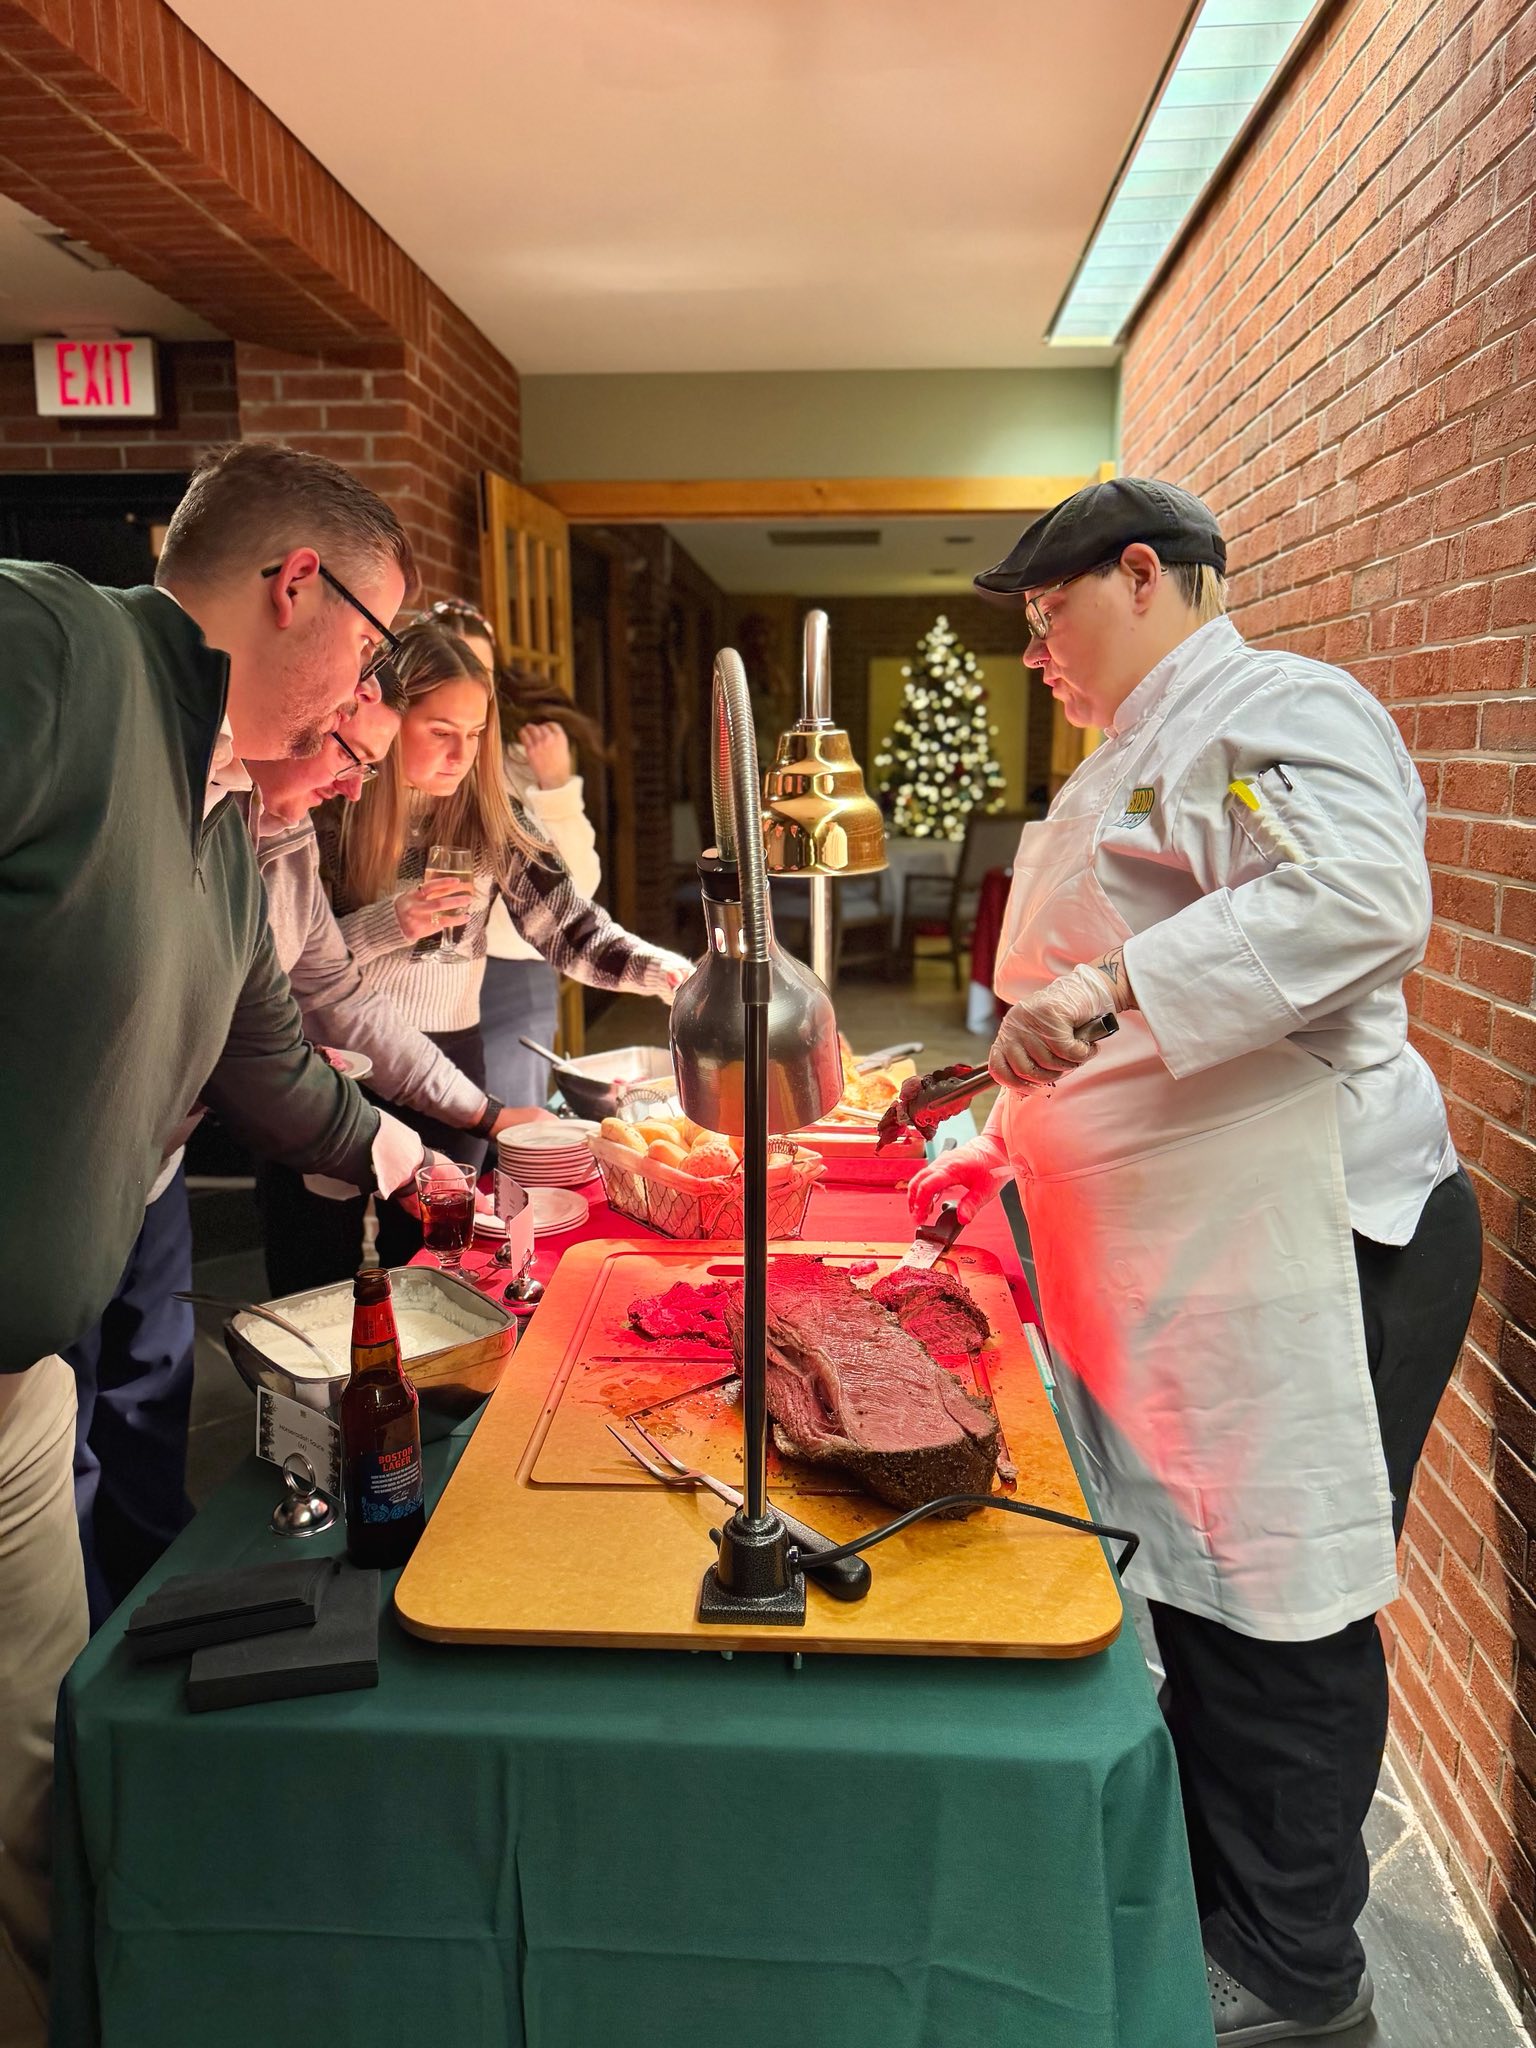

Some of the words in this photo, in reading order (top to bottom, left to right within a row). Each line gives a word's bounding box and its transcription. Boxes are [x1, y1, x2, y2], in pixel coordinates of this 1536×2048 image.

[56, 342, 134, 406] EXIT
[378, 1445, 413, 1465] BOSTON
[382, 1456, 411, 1472] LAGER
